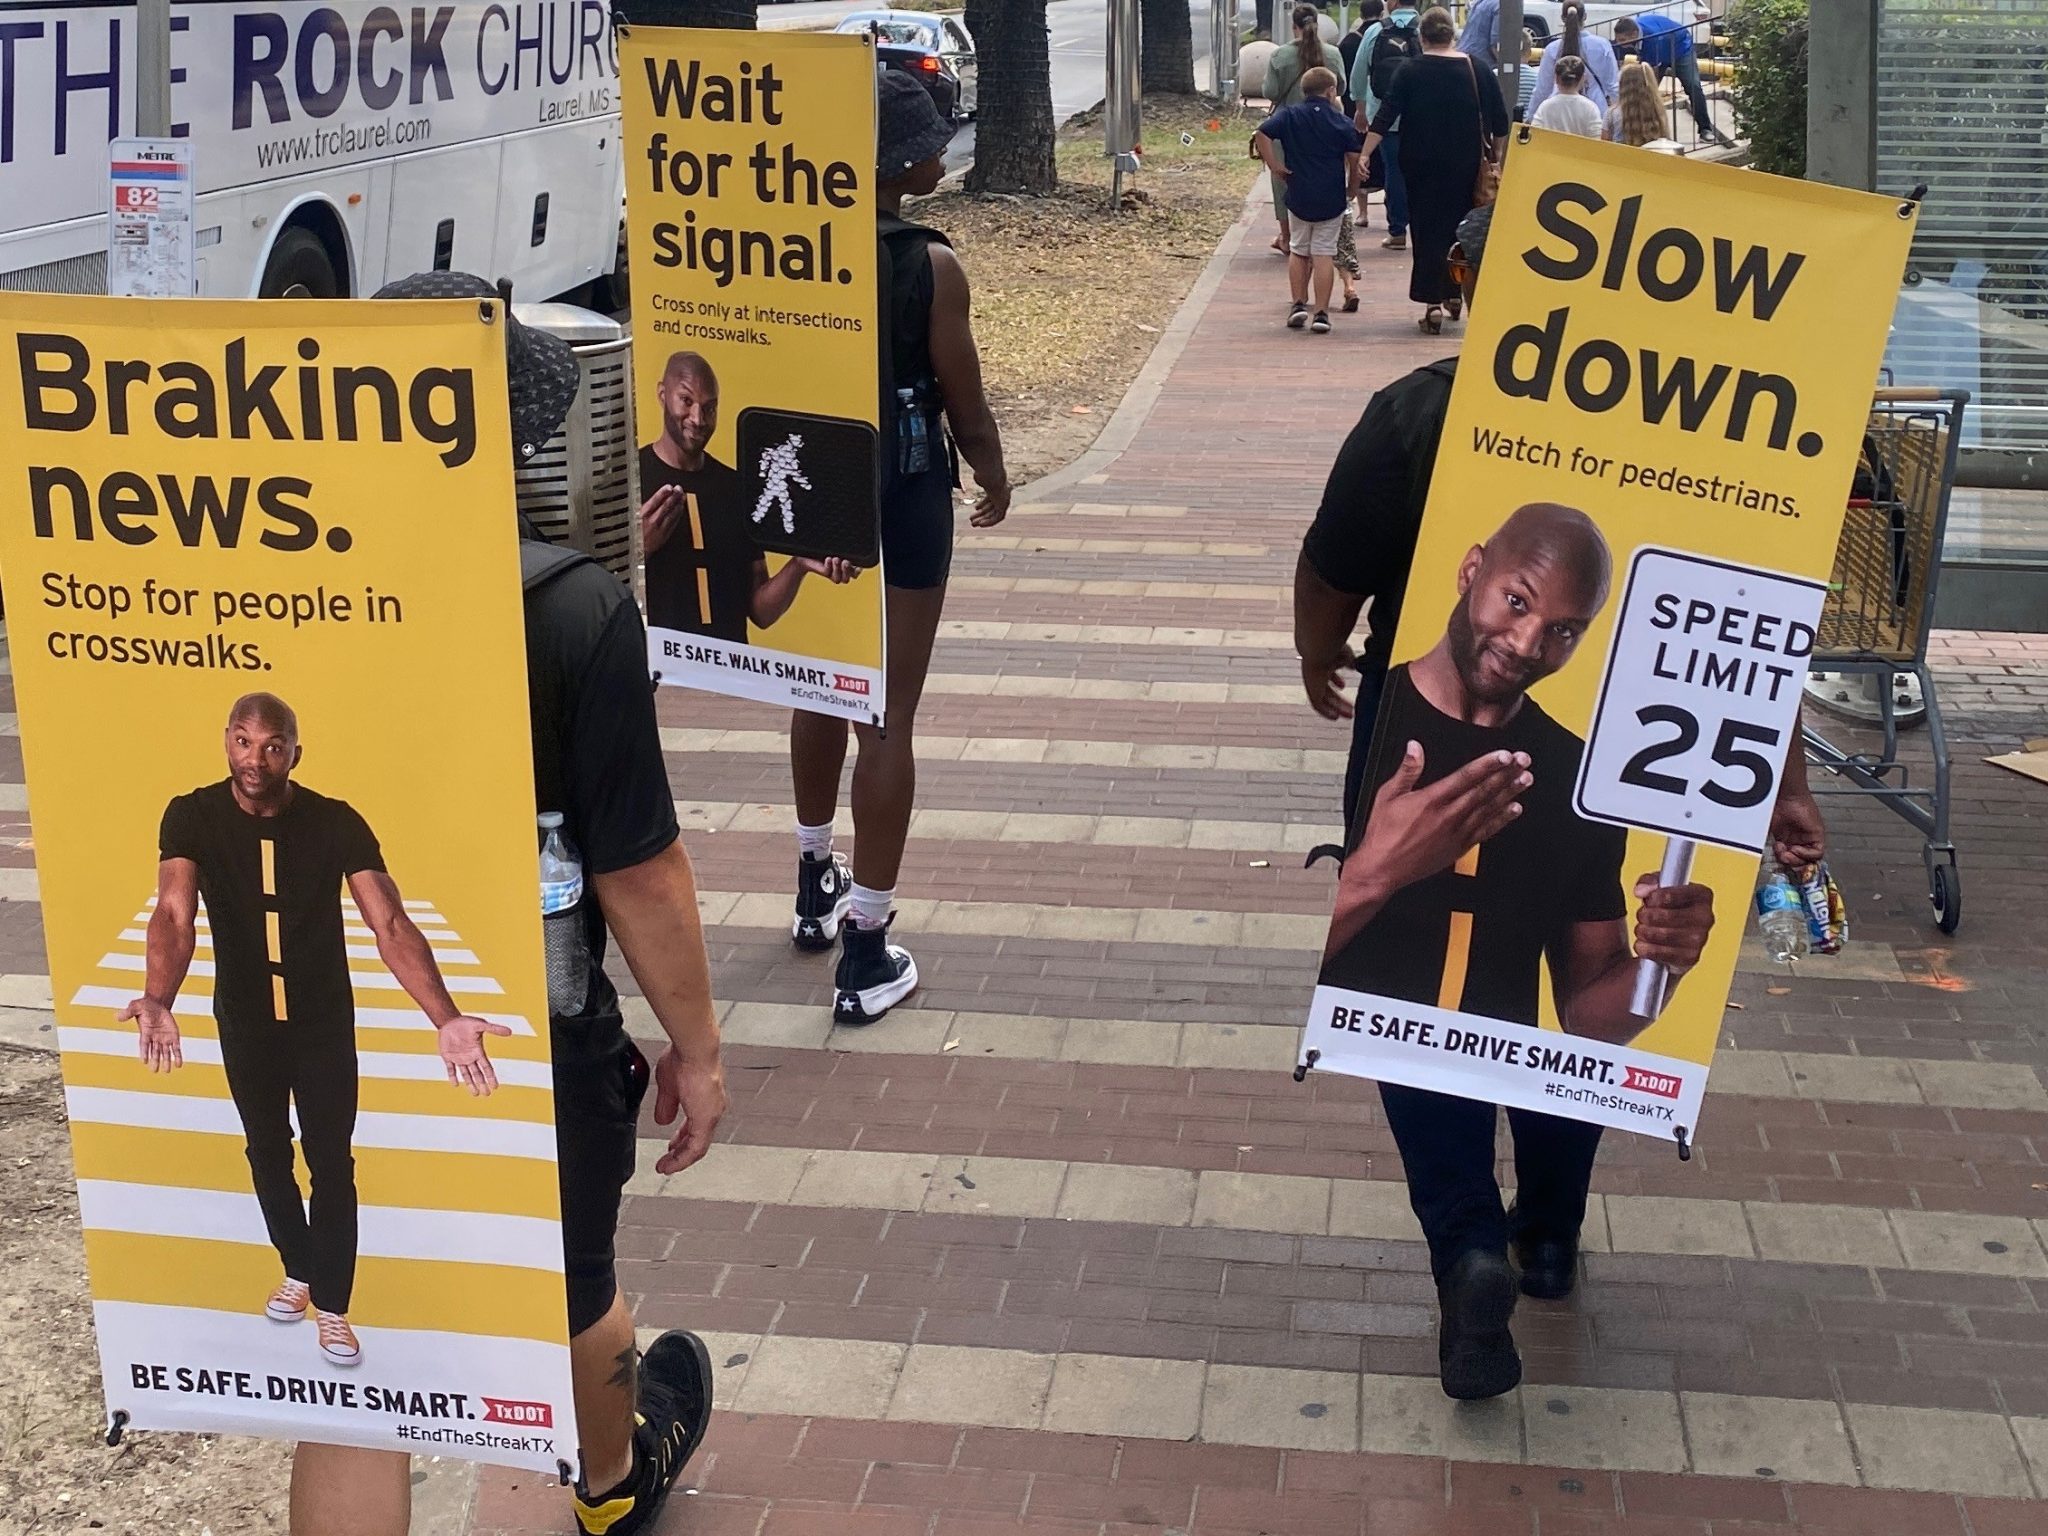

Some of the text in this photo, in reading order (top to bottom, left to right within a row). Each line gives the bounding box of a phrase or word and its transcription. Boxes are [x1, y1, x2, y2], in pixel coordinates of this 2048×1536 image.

[232, 6, 456, 130] ROCK
[643, 57, 783, 126] Wait
[589, 87, 610, 114] MS
[257, 117, 431, 169] www.trclaurel.com
[647, 133, 858, 209] for the
[127, 187, 159, 206] 82
[652, 209, 852, 288] signal.
[1521, 182, 1806, 322] Slow
[652, 294, 862, 332] Cross only at intersections
[653, 318, 772, 346] and crosswalks.
[16, 332, 477, 468] Braking
[1493, 306, 1824, 458] down.
[1472, 426, 1801, 519] Watch for pedestrians.
[28, 466, 352, 552] news.
[41, 572, 402, 628] Stop for people in
[1650, 593, 1817, 658] SPEED
[47, 629, 272, 671] crosswalks.
[663, 640, 830, 688] BE SAFE. WALK SMART.
[1653, 641, 1794, 701] LIMIT
[790, 686, 871, 712] #EndTheStreakTX
[839, 676, 868, 692] TxDOT
[1619, 704, 1781, 809] 25
[1330, 1006, 1615, 1086] BE SAFE. DRIVE SMART.
[1544, 1082, 1675, 1122] #EndTheStreakTX
[1633, 1071, 1678, 1095] TxDOT
[131, 1363, 476, 1420] BE SAFE. DRIVE SMART.
[494, 1403, 546, 1423] TxDOT
[396, 1424, 555, 1454] #EndTheStreakTX
